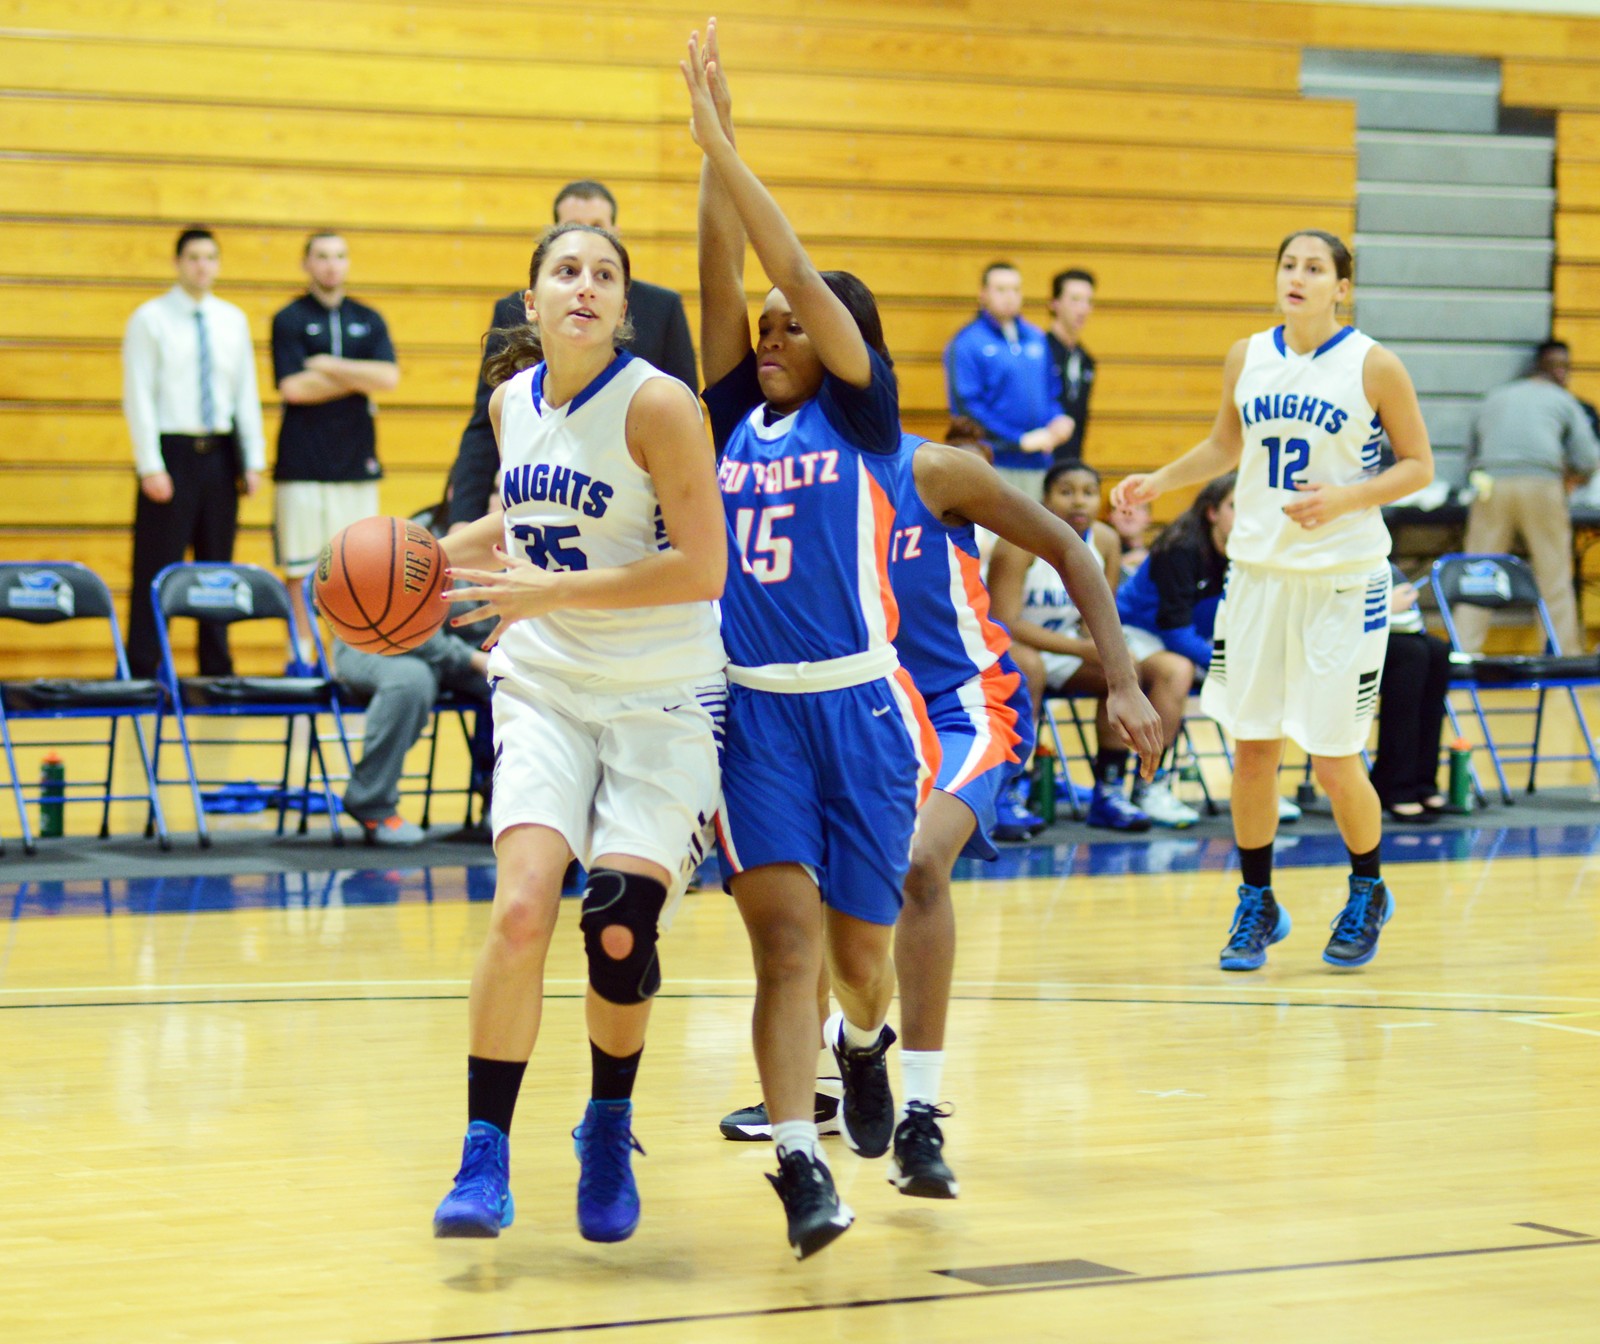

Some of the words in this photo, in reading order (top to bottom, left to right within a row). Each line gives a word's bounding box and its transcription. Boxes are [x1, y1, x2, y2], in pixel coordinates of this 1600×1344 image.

[1242, 394, 1348, 435] KNIGHTS
[1261, 436, 1310, 491] 12
[501, 463, 614, 519] NIGHTS
[510, 524, 589, 572] 35
[736, 503, 795, 584] 15
[404, 549, 432, 593] THE
